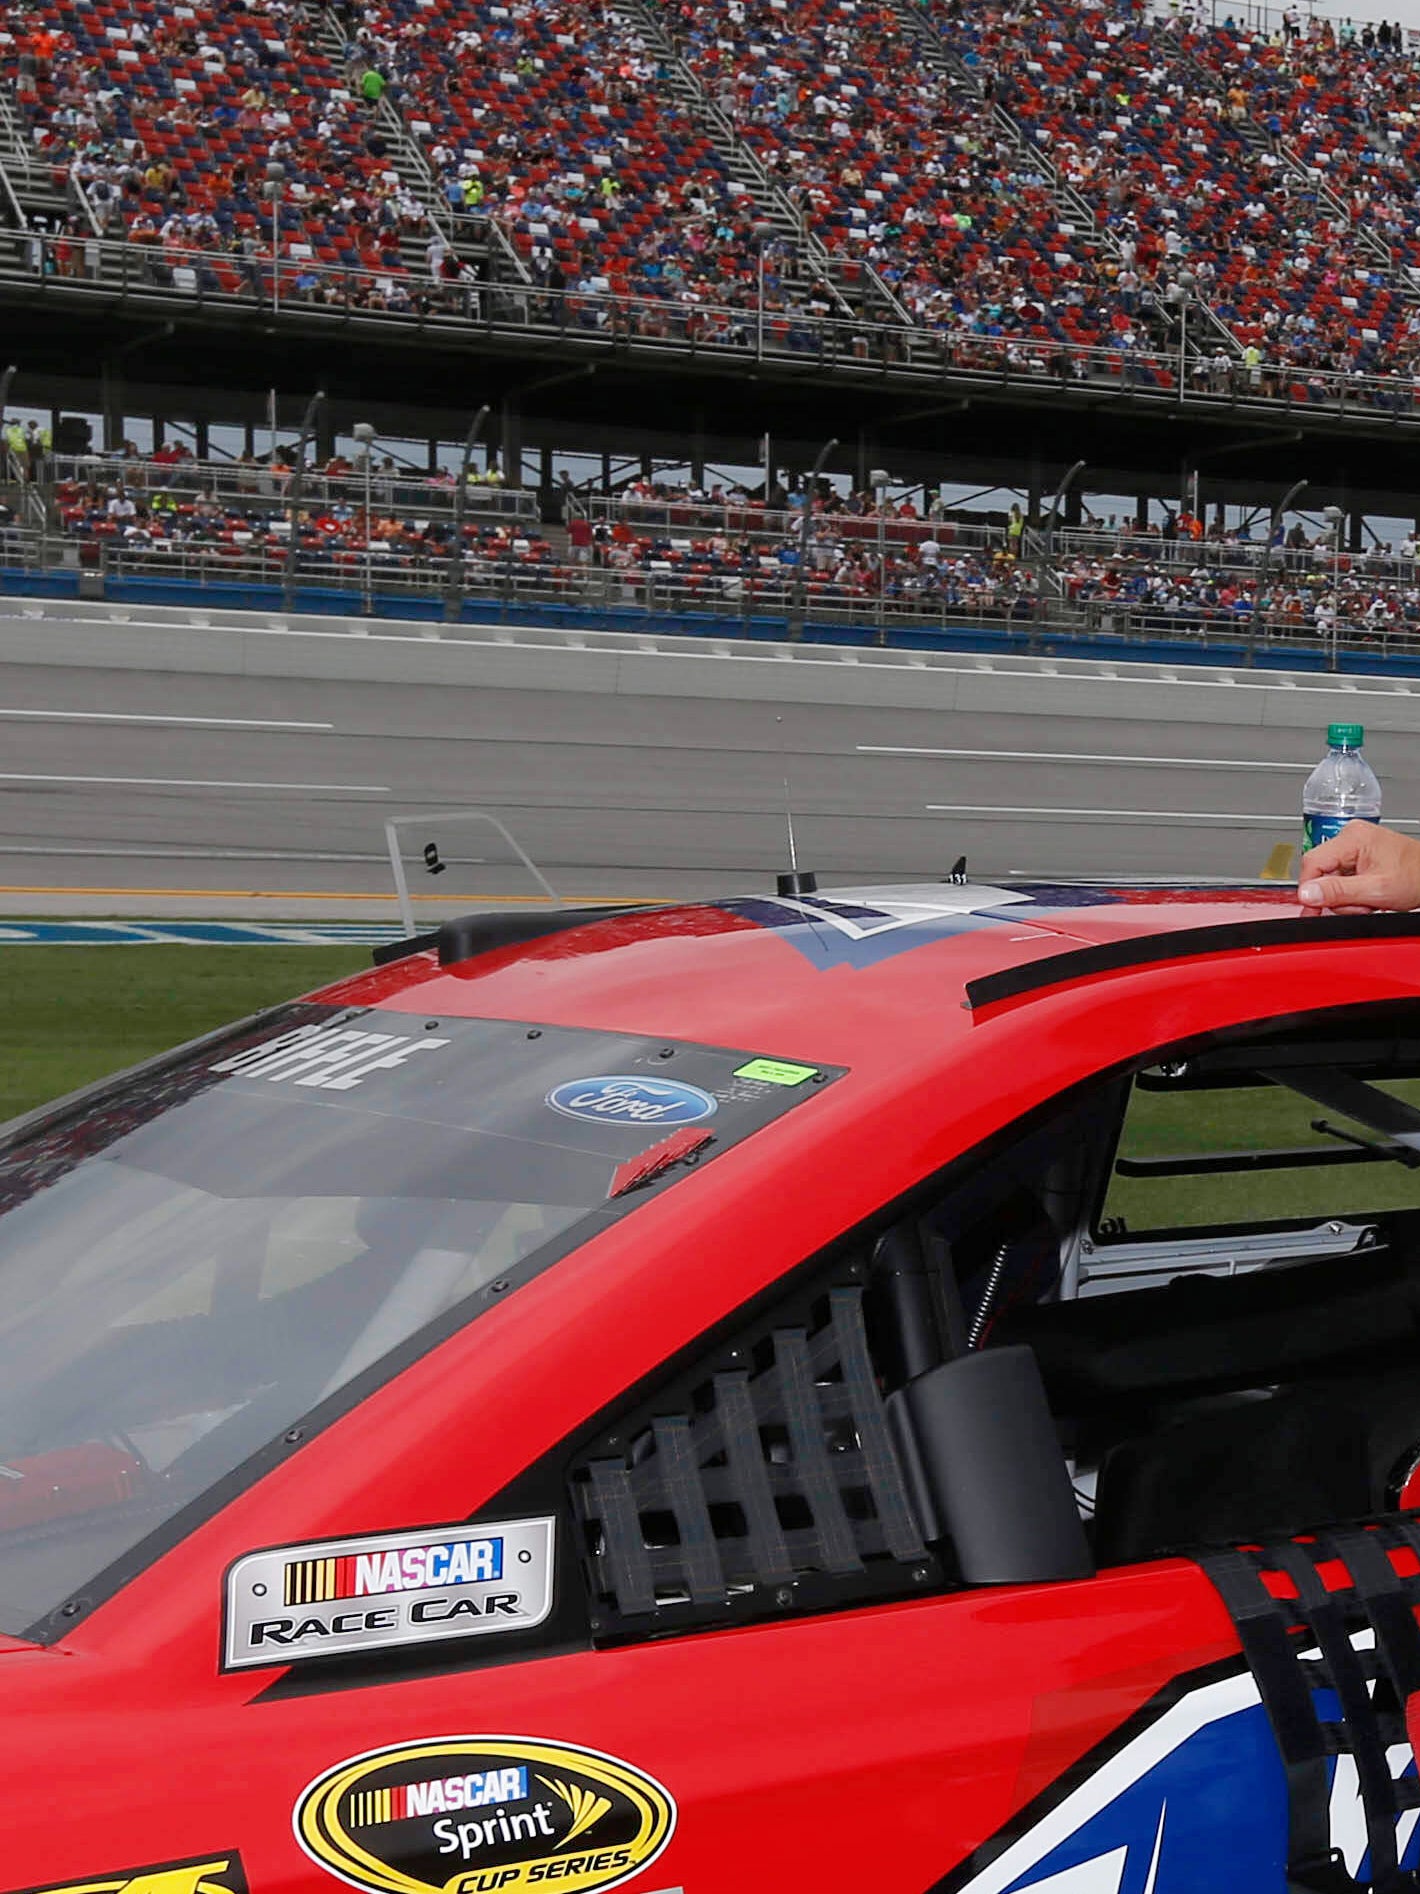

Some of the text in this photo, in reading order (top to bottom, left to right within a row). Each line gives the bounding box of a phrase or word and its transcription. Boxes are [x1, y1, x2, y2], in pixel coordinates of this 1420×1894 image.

[207, 1024, 452, 1090] BIFFLE
[569, 1081, 686, 1121] Ford
[354, 1540, 496, 1596] NASCAR
[251, 1594, 519, 1645] RACE CAR
[406, 1772, 524, 1818] NASCAR
[433, 1801, 555, 1859] Sprint
[457, 1849, 632, 1894] CUP SERIES
